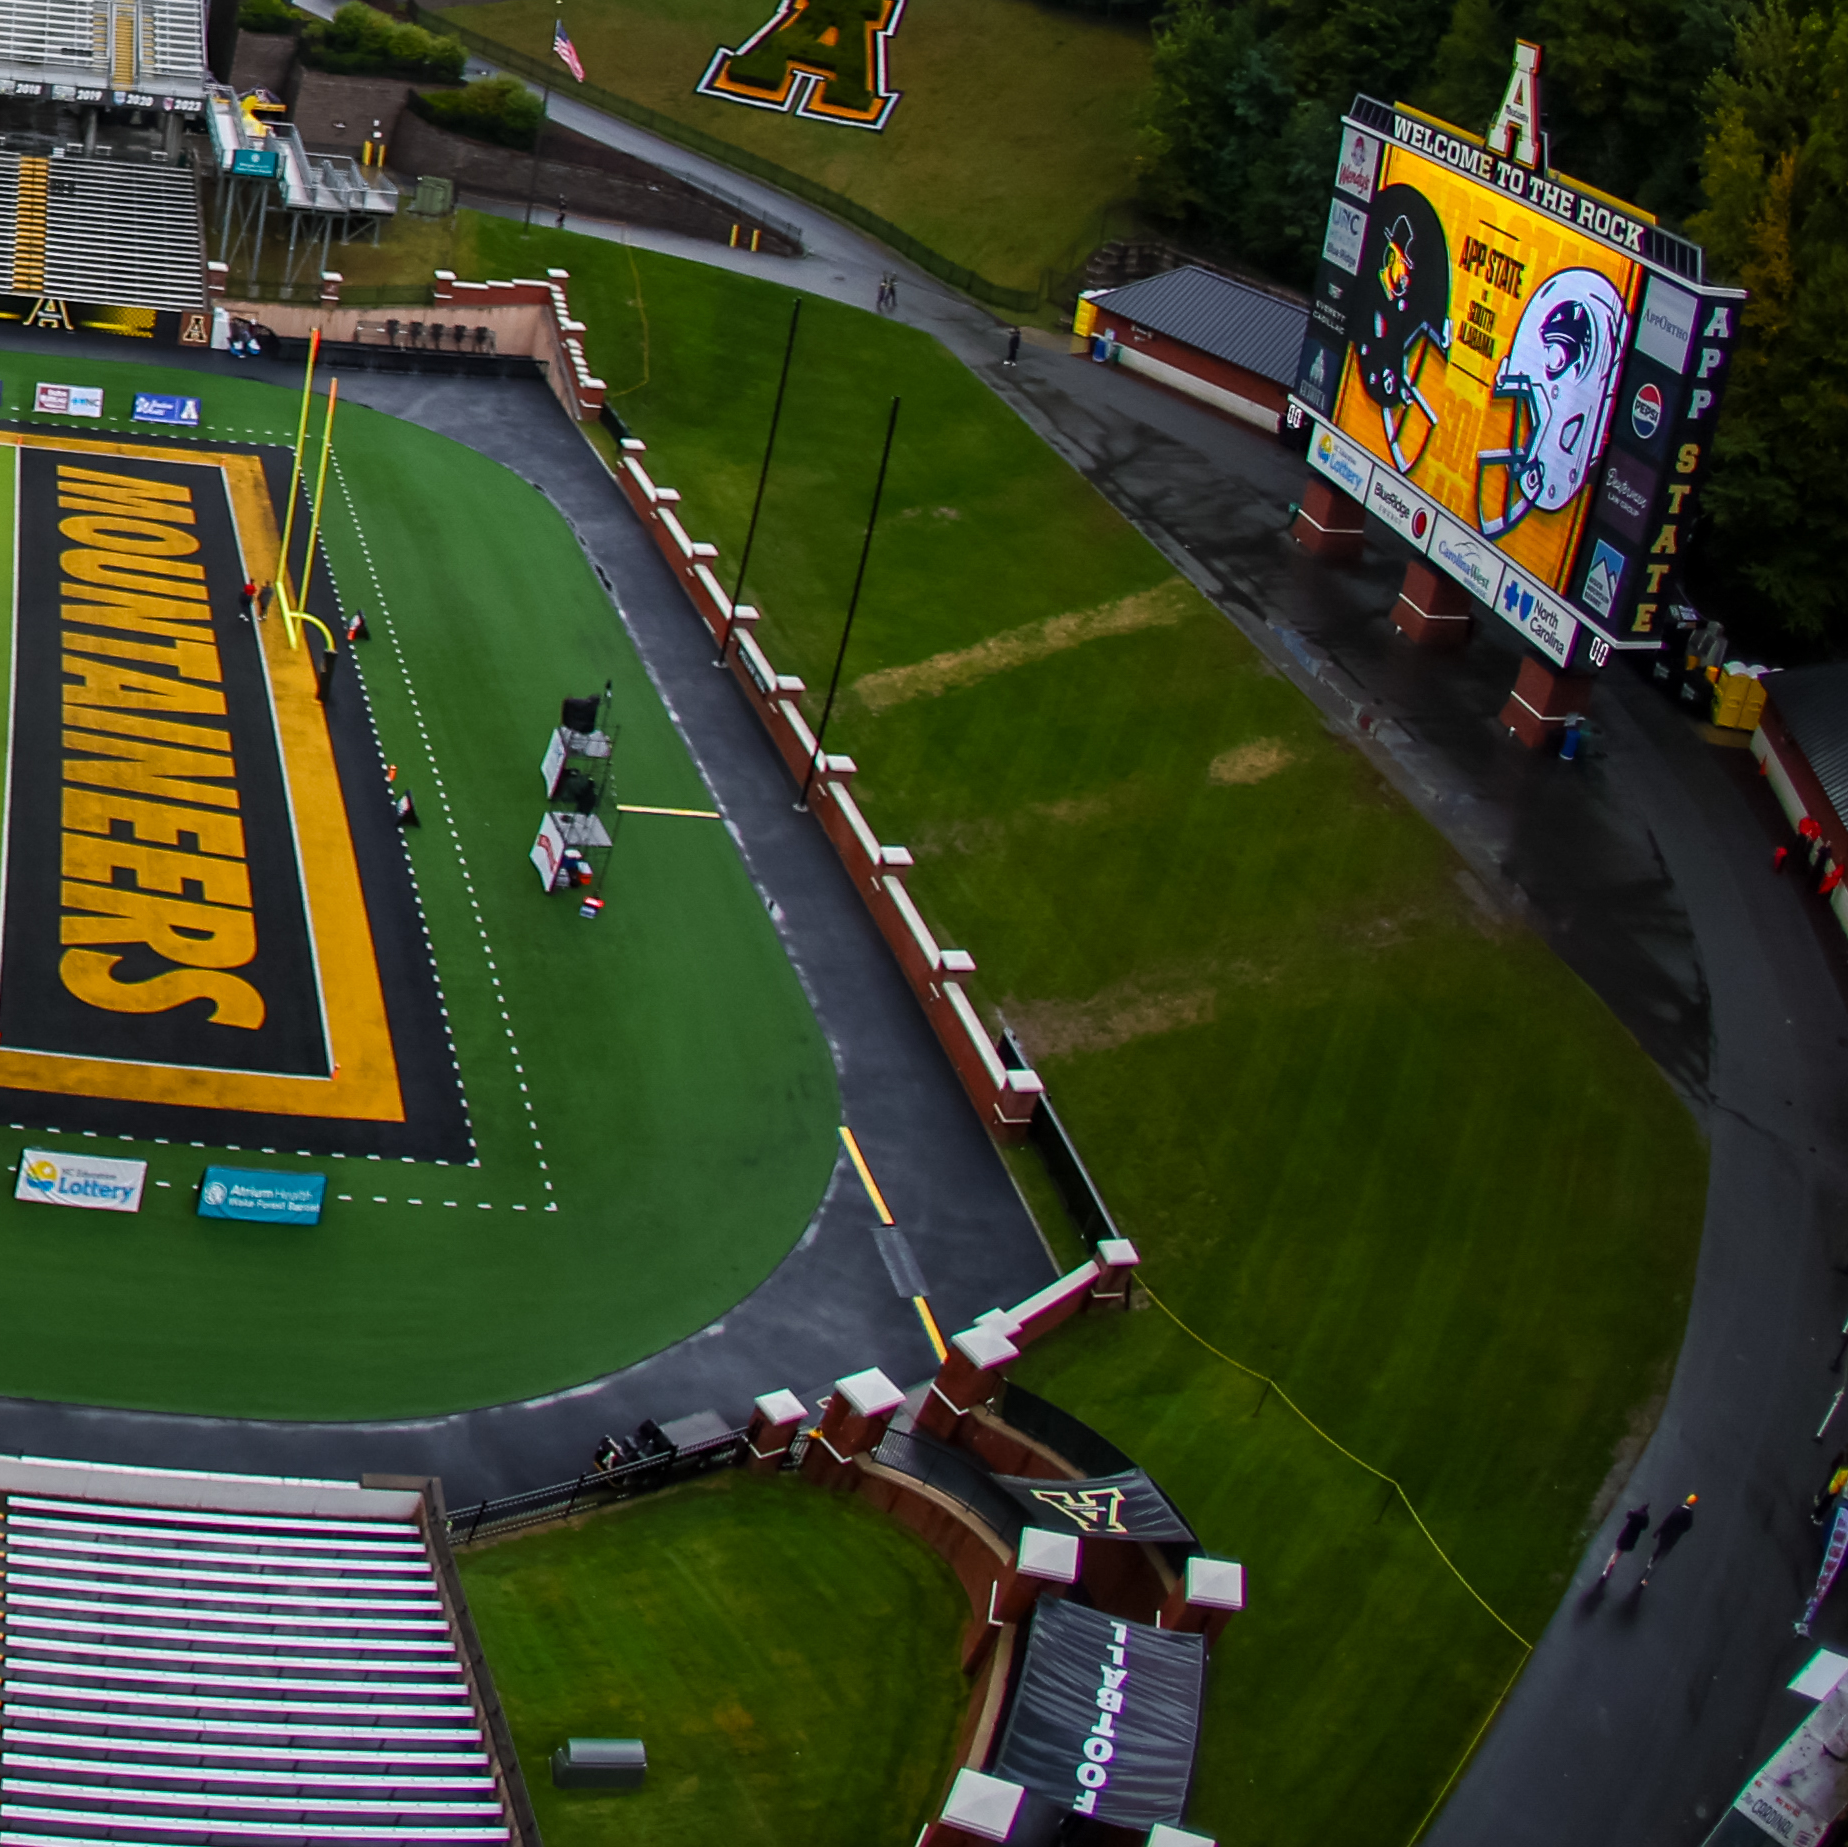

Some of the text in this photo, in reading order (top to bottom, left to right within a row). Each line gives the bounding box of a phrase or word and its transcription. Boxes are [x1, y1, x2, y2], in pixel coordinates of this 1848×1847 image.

[1394, 114, 1645, 253] WELCOME TO THE ROCK
[1458, 235, 1526, 300] APP STATE
[1634, 401, 1660, 423] PEPSI
[1328, 454, 1364, 493] Lottery
[1534, 598, 1559, 632] North
[1530, 617, 1565, 656] Carolina
[55, 464, 267, 1031] MOUNTAINEERS
[58, 1177, 135, 1204] Lottery
[230, 1185, 313, 1202] Atrium Health
[1073, 1621, 1128, 1815] FOOTBALL
